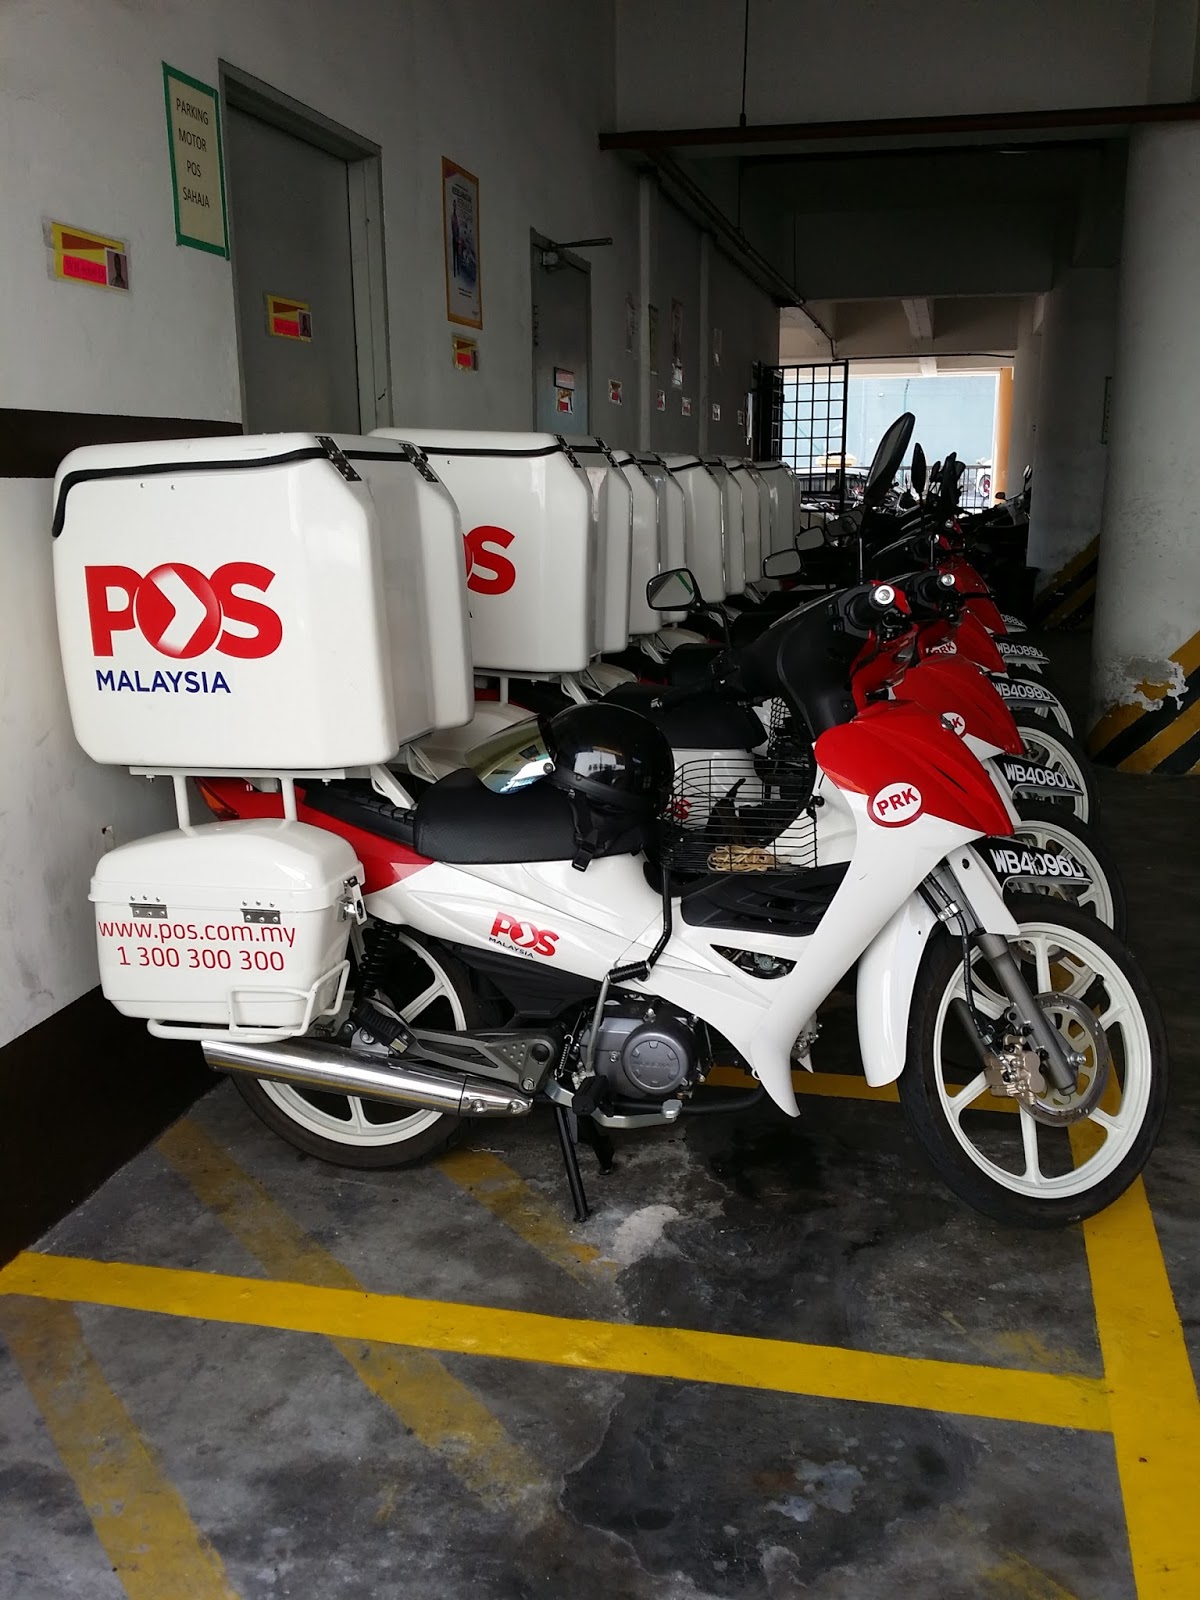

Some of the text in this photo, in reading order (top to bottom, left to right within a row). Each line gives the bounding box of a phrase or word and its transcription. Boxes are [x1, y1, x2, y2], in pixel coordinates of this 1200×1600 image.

[176, 98, 209, 125] PARKING
[178, 128, 207, 152] MOTOR
[187, 160, 202, 178] POS
[182, 186, 210, 208] SAHAJA
[85, 562, 283, 659] POS
[96, 669, 231, 694] MALAYSIA
[876, 787, 919, 816] PRK
[99, 921, 295, 948] www.pos.com.my
[490, 911, 560, 957] POS
[116, 946, 285, 971] 1 300 300 300
[488, 936, 534, 958] MALAYSIA
